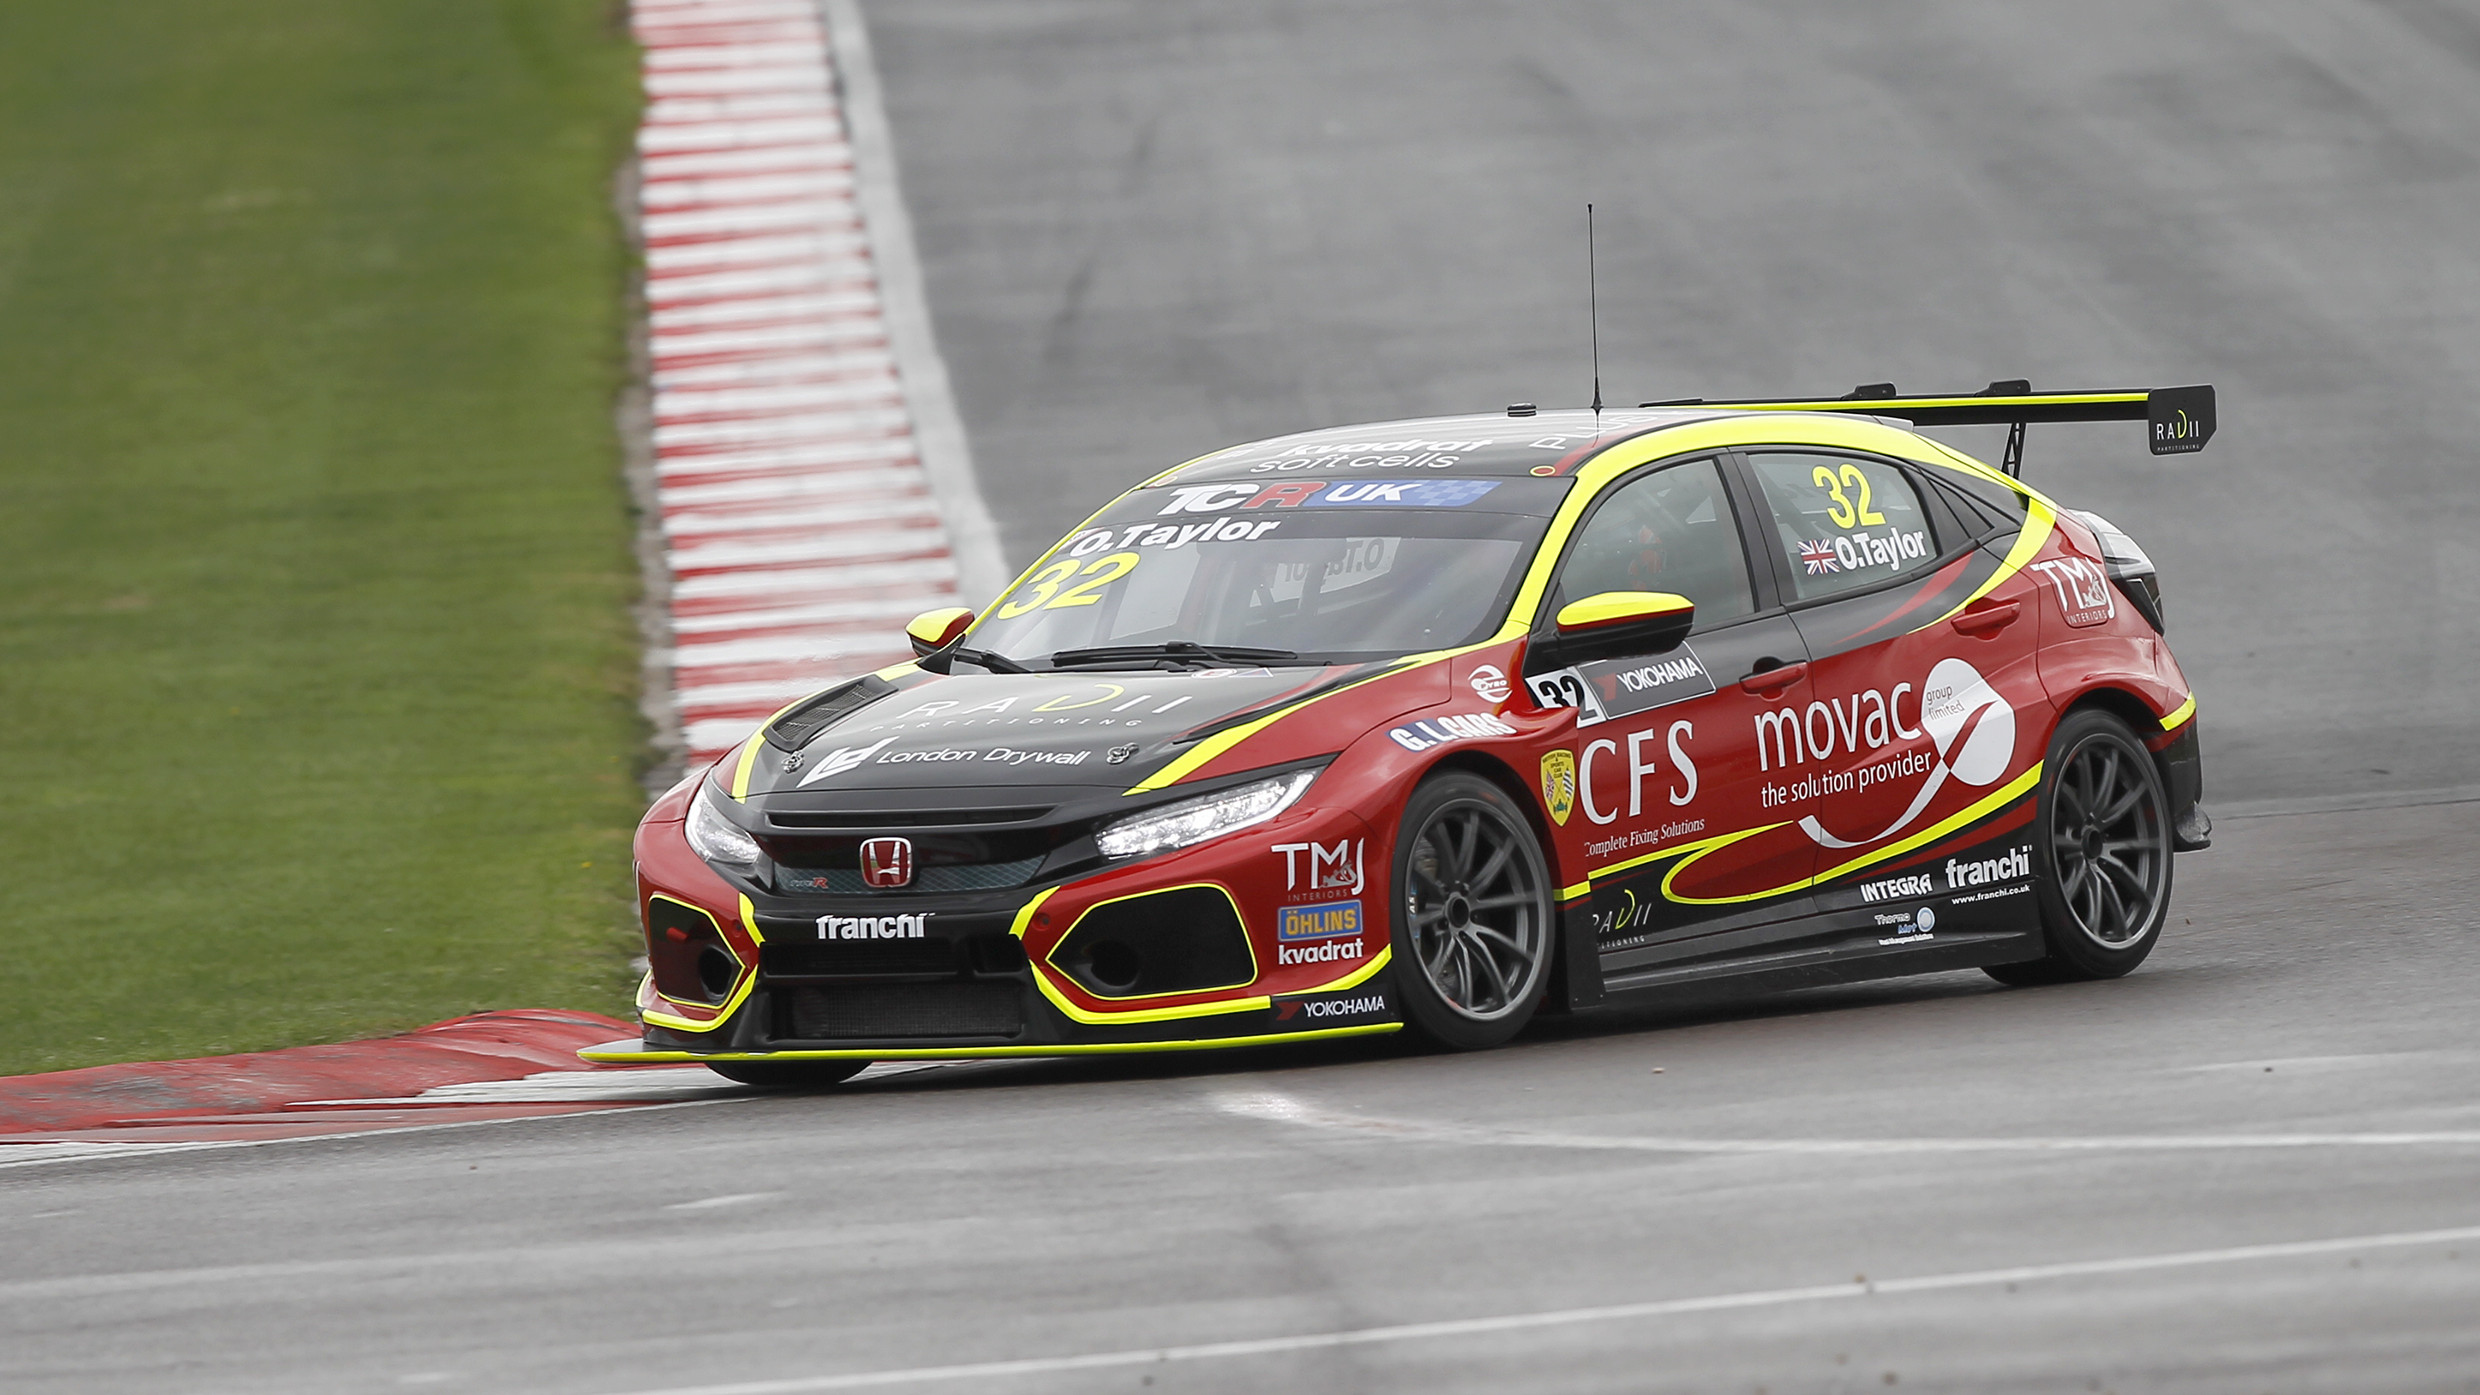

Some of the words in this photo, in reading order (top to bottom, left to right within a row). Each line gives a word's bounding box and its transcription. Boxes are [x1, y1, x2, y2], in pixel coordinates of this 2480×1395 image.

[2156, 409, 2199, 440] RADII
[1156, 481, 1327, 516] TCR
[1325, 482, 1423, 503] UK
[1811, 463, 1886, 529] 32
[1070, 516, 1281, 557] O.Taylor
[1834, 526, 1927, 571] O.Taylor
[997, 551, 1140, 620] 32
[2029, 556, 2115, 619] TMJ
[1616, 656, 1705, 693] YOKOHAMA
[896, 683, 1193, 719] RADII
[1538, 675, 1596, 720] 32
[1926, 685, 1953, 706] group
[1928, 700, 1965, 721] limited
[1753, 682, 1923, 772] movac
[876, 747, 977, 765] London
[983, 747, 1092, 766] Drywall
[1579, 720, 1698, 825] CFS
[1761, 782, 1787, 808] the
[1791, 772, 1854, 802] solution
[1858, 749, 1932, 793] provider
[1630, 828, 1659, 845] Fixing
[1660, 818, 1705, 840] Solutions
[1271, 838, 1364, 896] TMJ
[1945, 845, 2031, 889] franchi
[1287, 889, 1348, 902] INTERIORS
[1860, 873, 1933, 902] INTEGRA
[1951, 884, 2031, 905] www.franchi.co.uk
[815, 914, 927, 940] franchi
[1286, 909, 1357, 936] ÖHLINS
[1278, 938, 1364, 965] kvadrat
[1304, 995, 1385, 1018] YOKOHAMA
